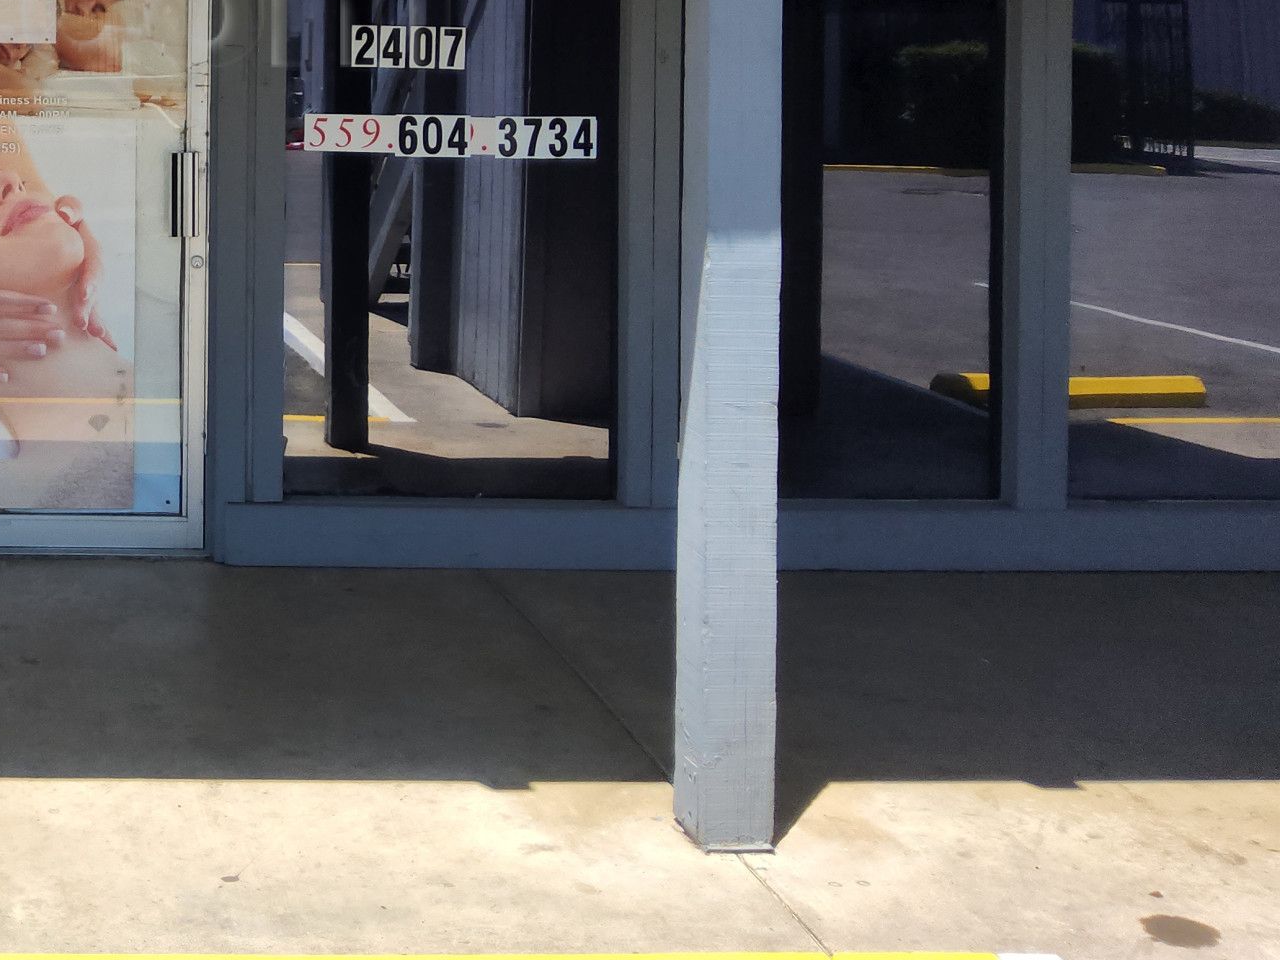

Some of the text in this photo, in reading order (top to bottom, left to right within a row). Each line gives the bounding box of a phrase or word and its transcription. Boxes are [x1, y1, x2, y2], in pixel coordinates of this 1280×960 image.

[354, 26, 463, 67] 2407
[33, 96, 68, 105] Hours
[31, 110, 70, 120] :00PM
